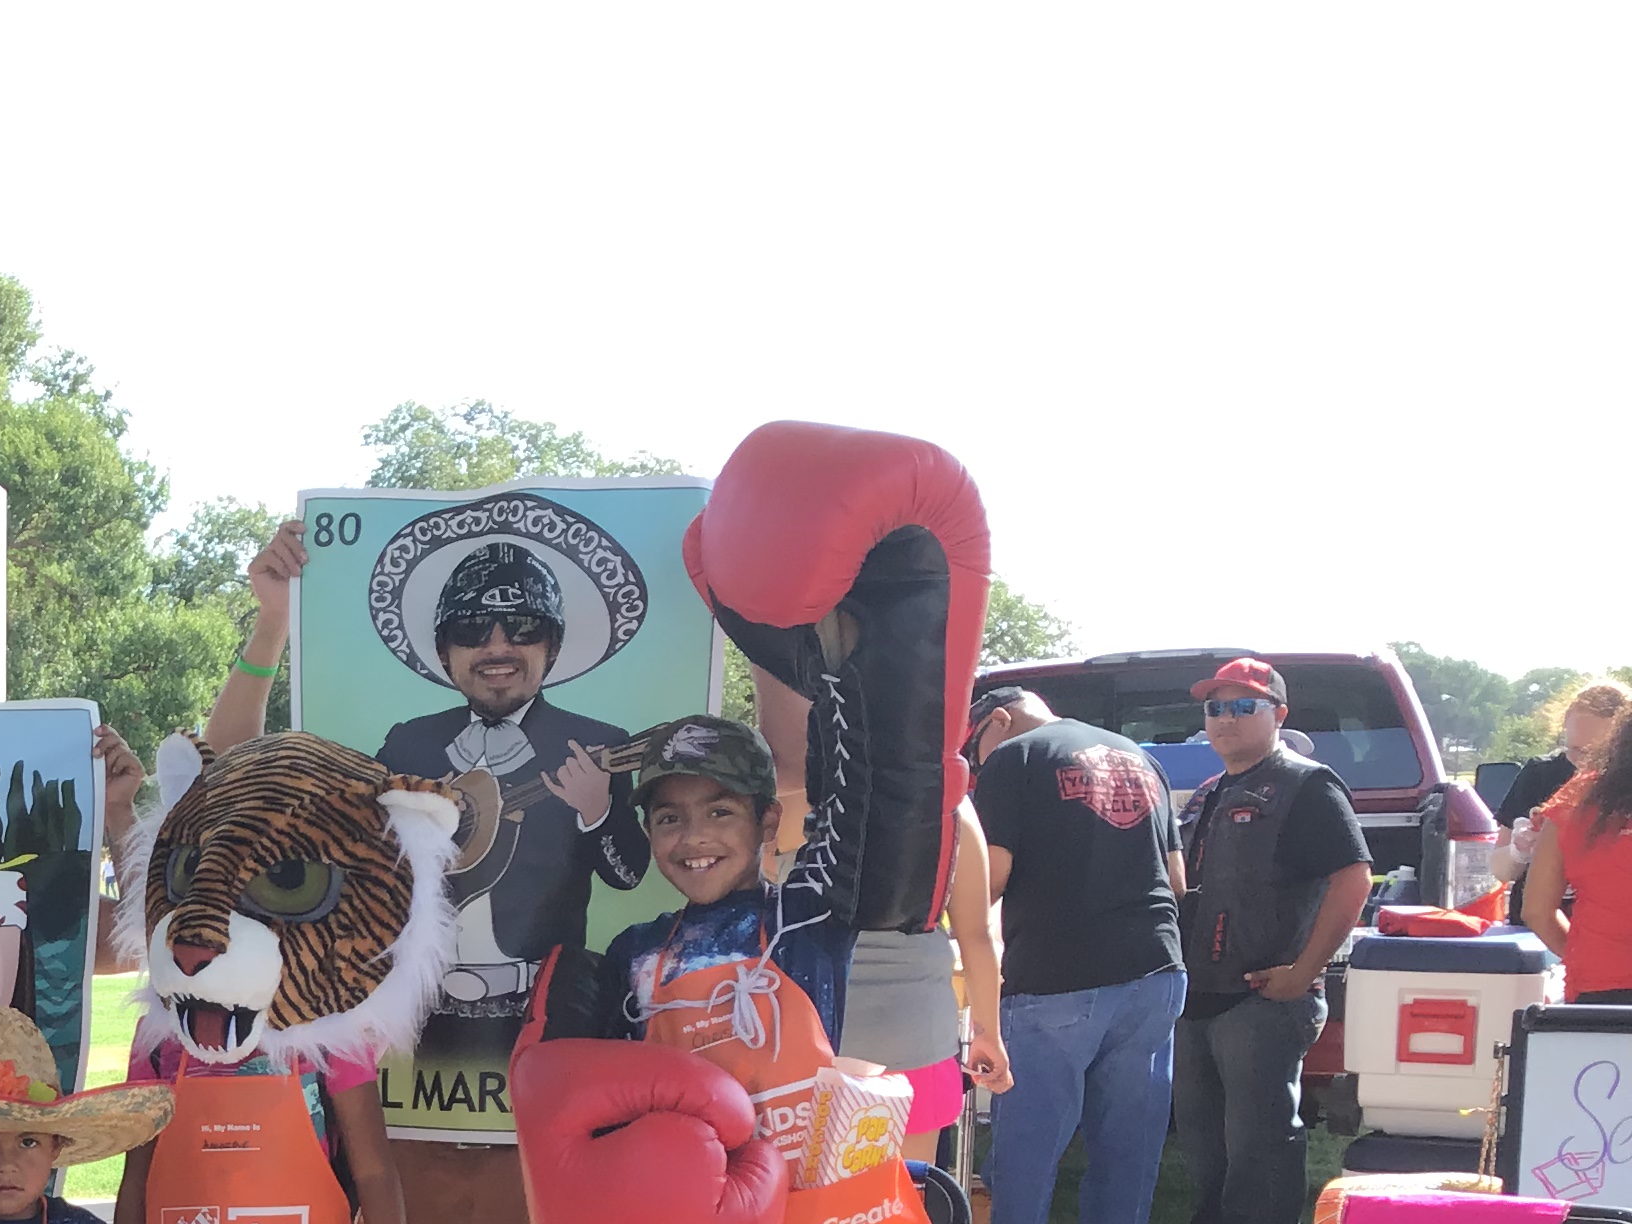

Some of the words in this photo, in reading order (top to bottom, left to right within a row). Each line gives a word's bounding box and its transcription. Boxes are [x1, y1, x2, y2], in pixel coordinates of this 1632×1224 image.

[314, 512, 362, 548] 80
[376, 1067, 403, 1109] L
[412, 1069, 513, 1113] MAR
